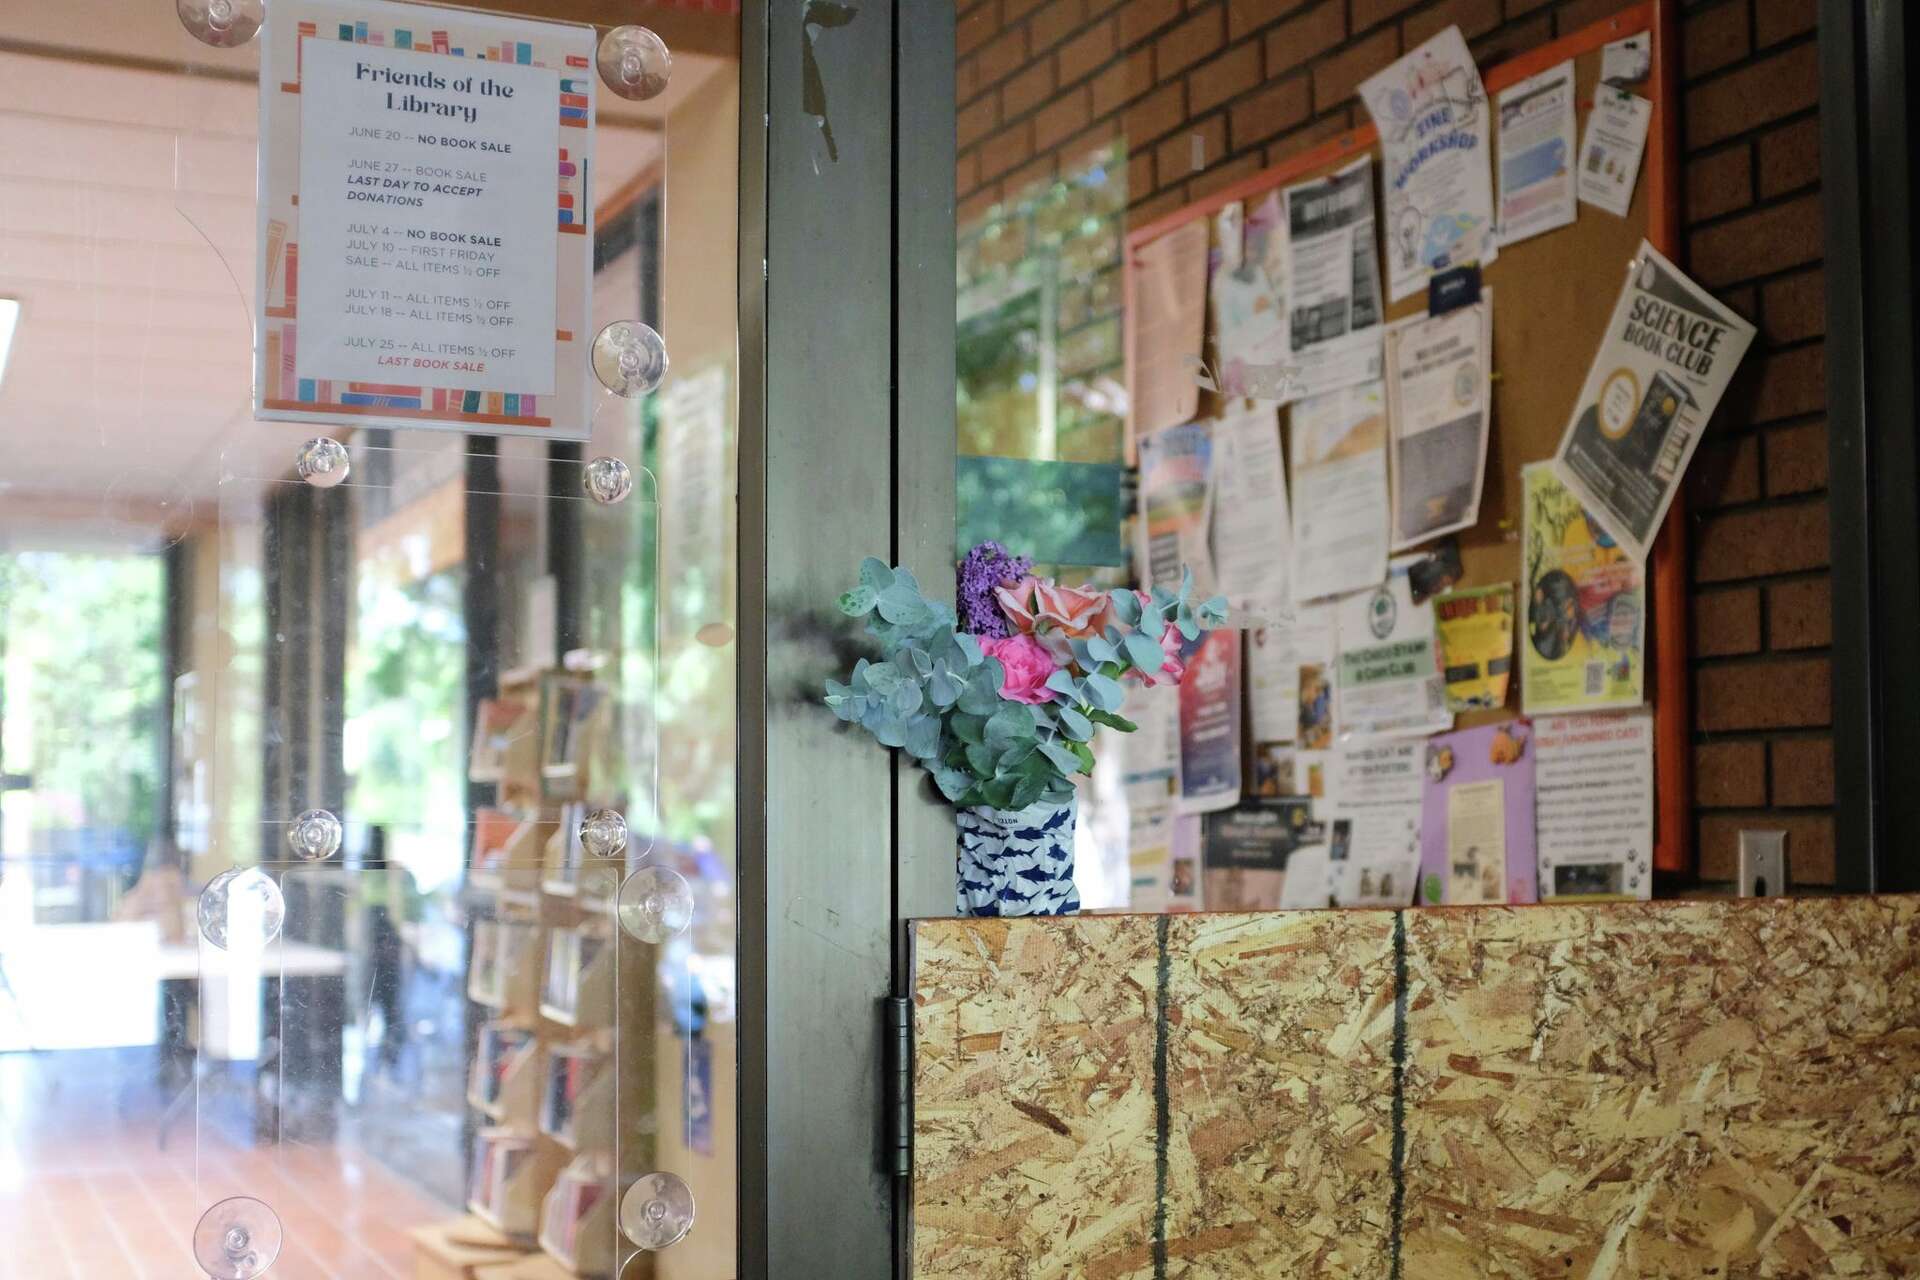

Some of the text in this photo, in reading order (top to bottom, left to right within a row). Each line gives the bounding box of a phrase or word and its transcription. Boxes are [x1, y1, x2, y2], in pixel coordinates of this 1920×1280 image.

[356, 62, 514, 98] Friends of the
[386, 92, 477, 124] Library
[348, 126, 383, 139] JUNE
[385, 129, 401, 142] 20
[418, 134, 437, 145] NO
[441, 136, 477, 150] BOOK
[480, 142, 512, 154] SALE
[1394, 127, 1479, 190] WORKSHOP
[347, 159, 381, 172] JUNE
[384, 161, 400, 173] 27
[415, 165, 452, 178] BOOK
[455, 170, 487, 183] SALE
[347, 175, 483, 197] LAST DAY TO ACCEPT
[346, 190, 424, 207] DONATIONS
[346, 224, 378, 236] JULY
[381, 226, 390, 237] 4
[407, 228, 426, 240] NO
[430, 230, 467, 244] BOOK
[470, 234, 502, 247] SALE
[346, 239, 378, 252] JULY
[382, 242, 395, 253] 10
[411, 245, 446, 258] FIRST
[450, 248, 495, 263] FRIDAY
[345, 255, 378, 268] SALE
[395, 260, 419, 272] ALL
[423, 262, 460, 275] ITEMS
[476, 267, 501, 279] OFF
[345, 288, 377, 300] JULY
[381, 290, 390, 301] 11
[406, 293, 430, 305] ALL
[433, 295, 470, 308] ITEMS
[486, 300, 512, 311] OFF
[345, 304, 377, 316] JULY
[381, 306, 393, 317] 18
[409, 309, 433, 321] ALL
[436, 311, 473, 324] ITEMS
[489, 316, 514, 327] OFF
[1630, 295, 1728, 355] SCIENCE
[343, 335, 376, 348] JULY
[379, 338, 395, 350] 25
[410, 341, 434, 353] ALL
[438, 343, 475, 356] ITEMS
[490, 348, 516, 360] OFF
[1623, 322, 1715, 376] BOOK CLUB
[377, 355, 486, 373] LAST BOOK SALE
